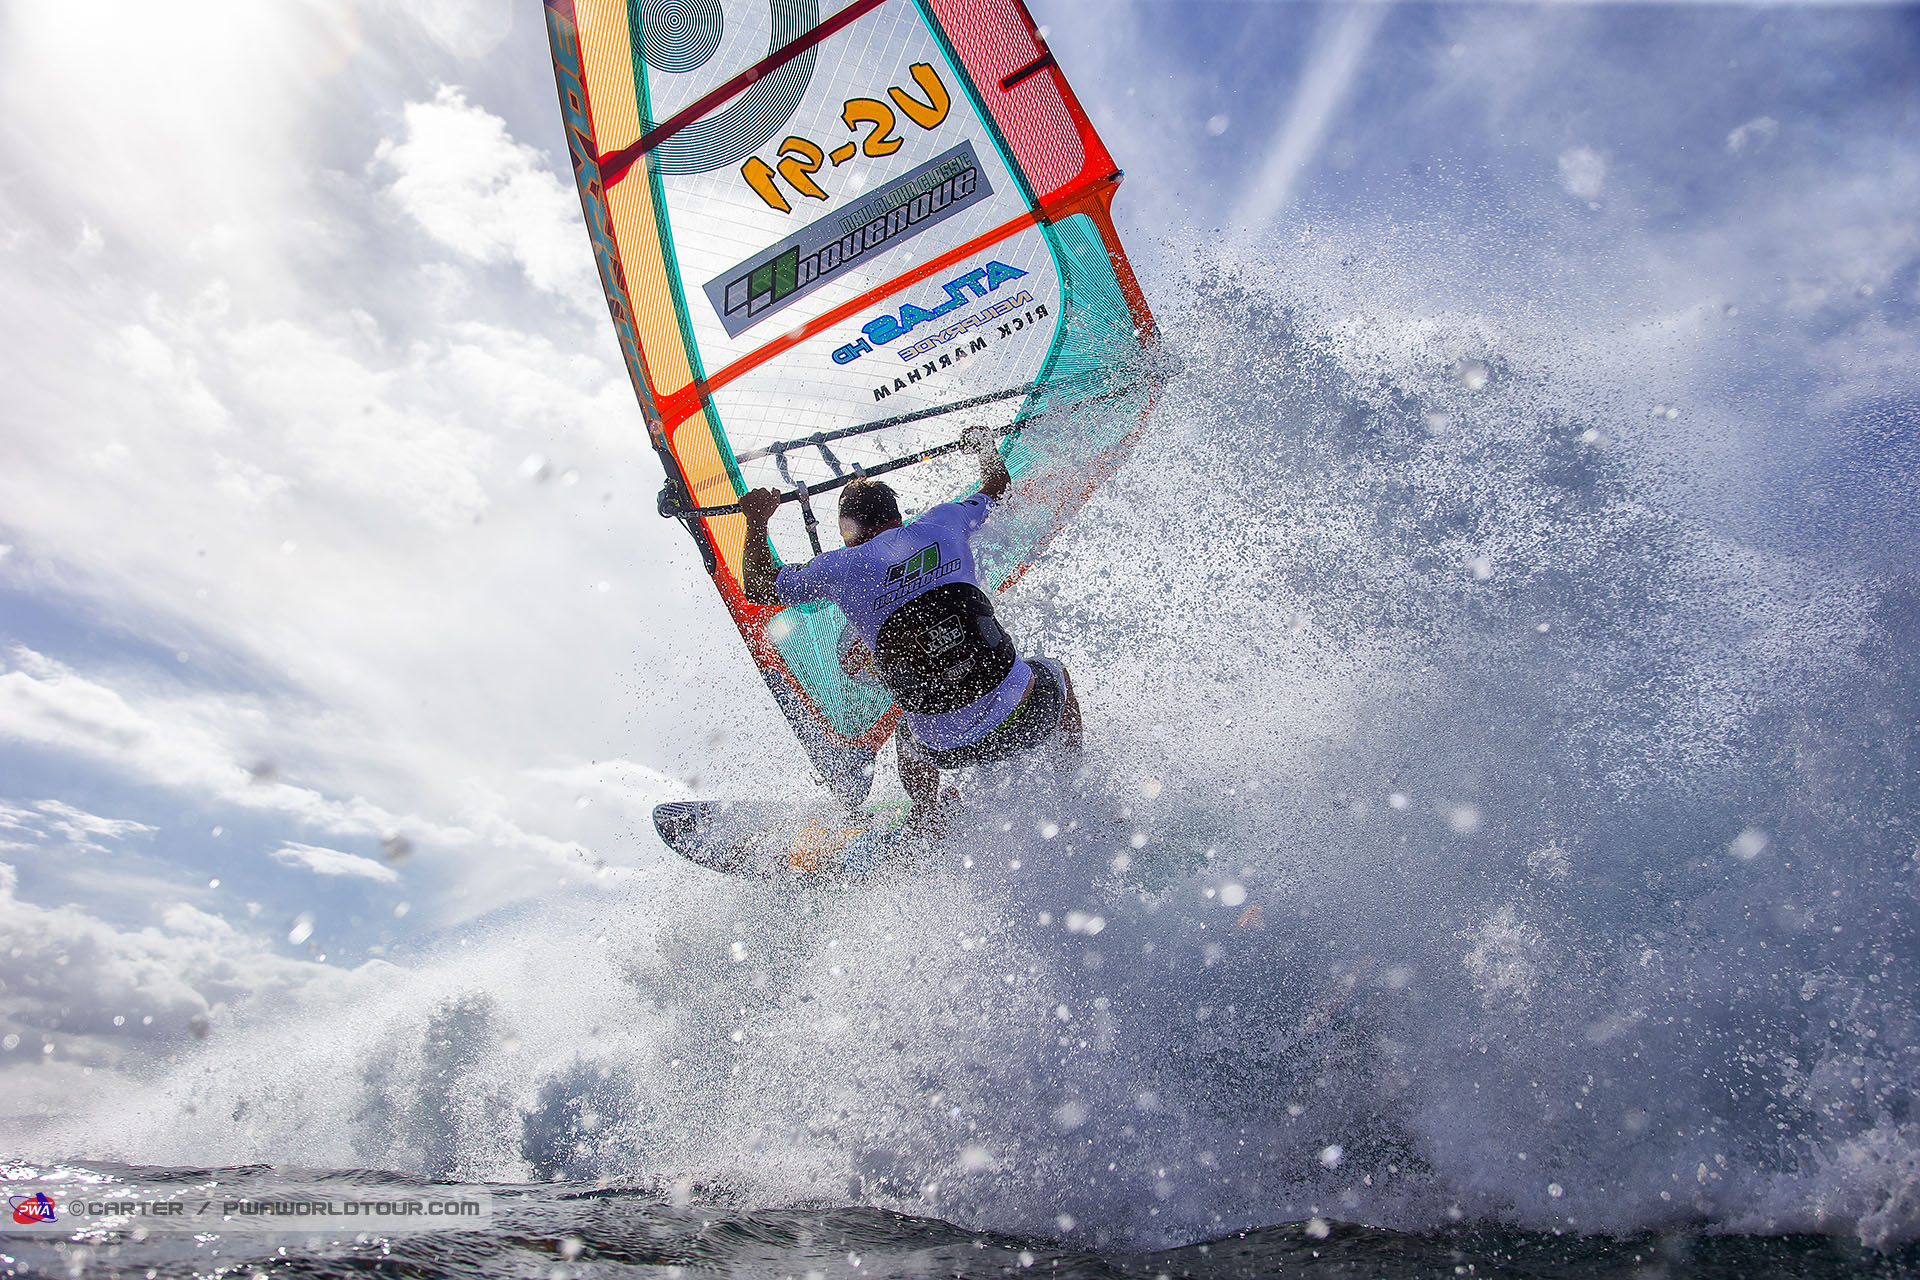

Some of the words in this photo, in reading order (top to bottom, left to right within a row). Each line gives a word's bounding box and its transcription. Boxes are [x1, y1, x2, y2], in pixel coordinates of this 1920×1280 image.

[838, 204, 876, 234] MAUI
[873, 181, 918, 215] ALOHA
[917, 152, 973, 190] CLASSIC
